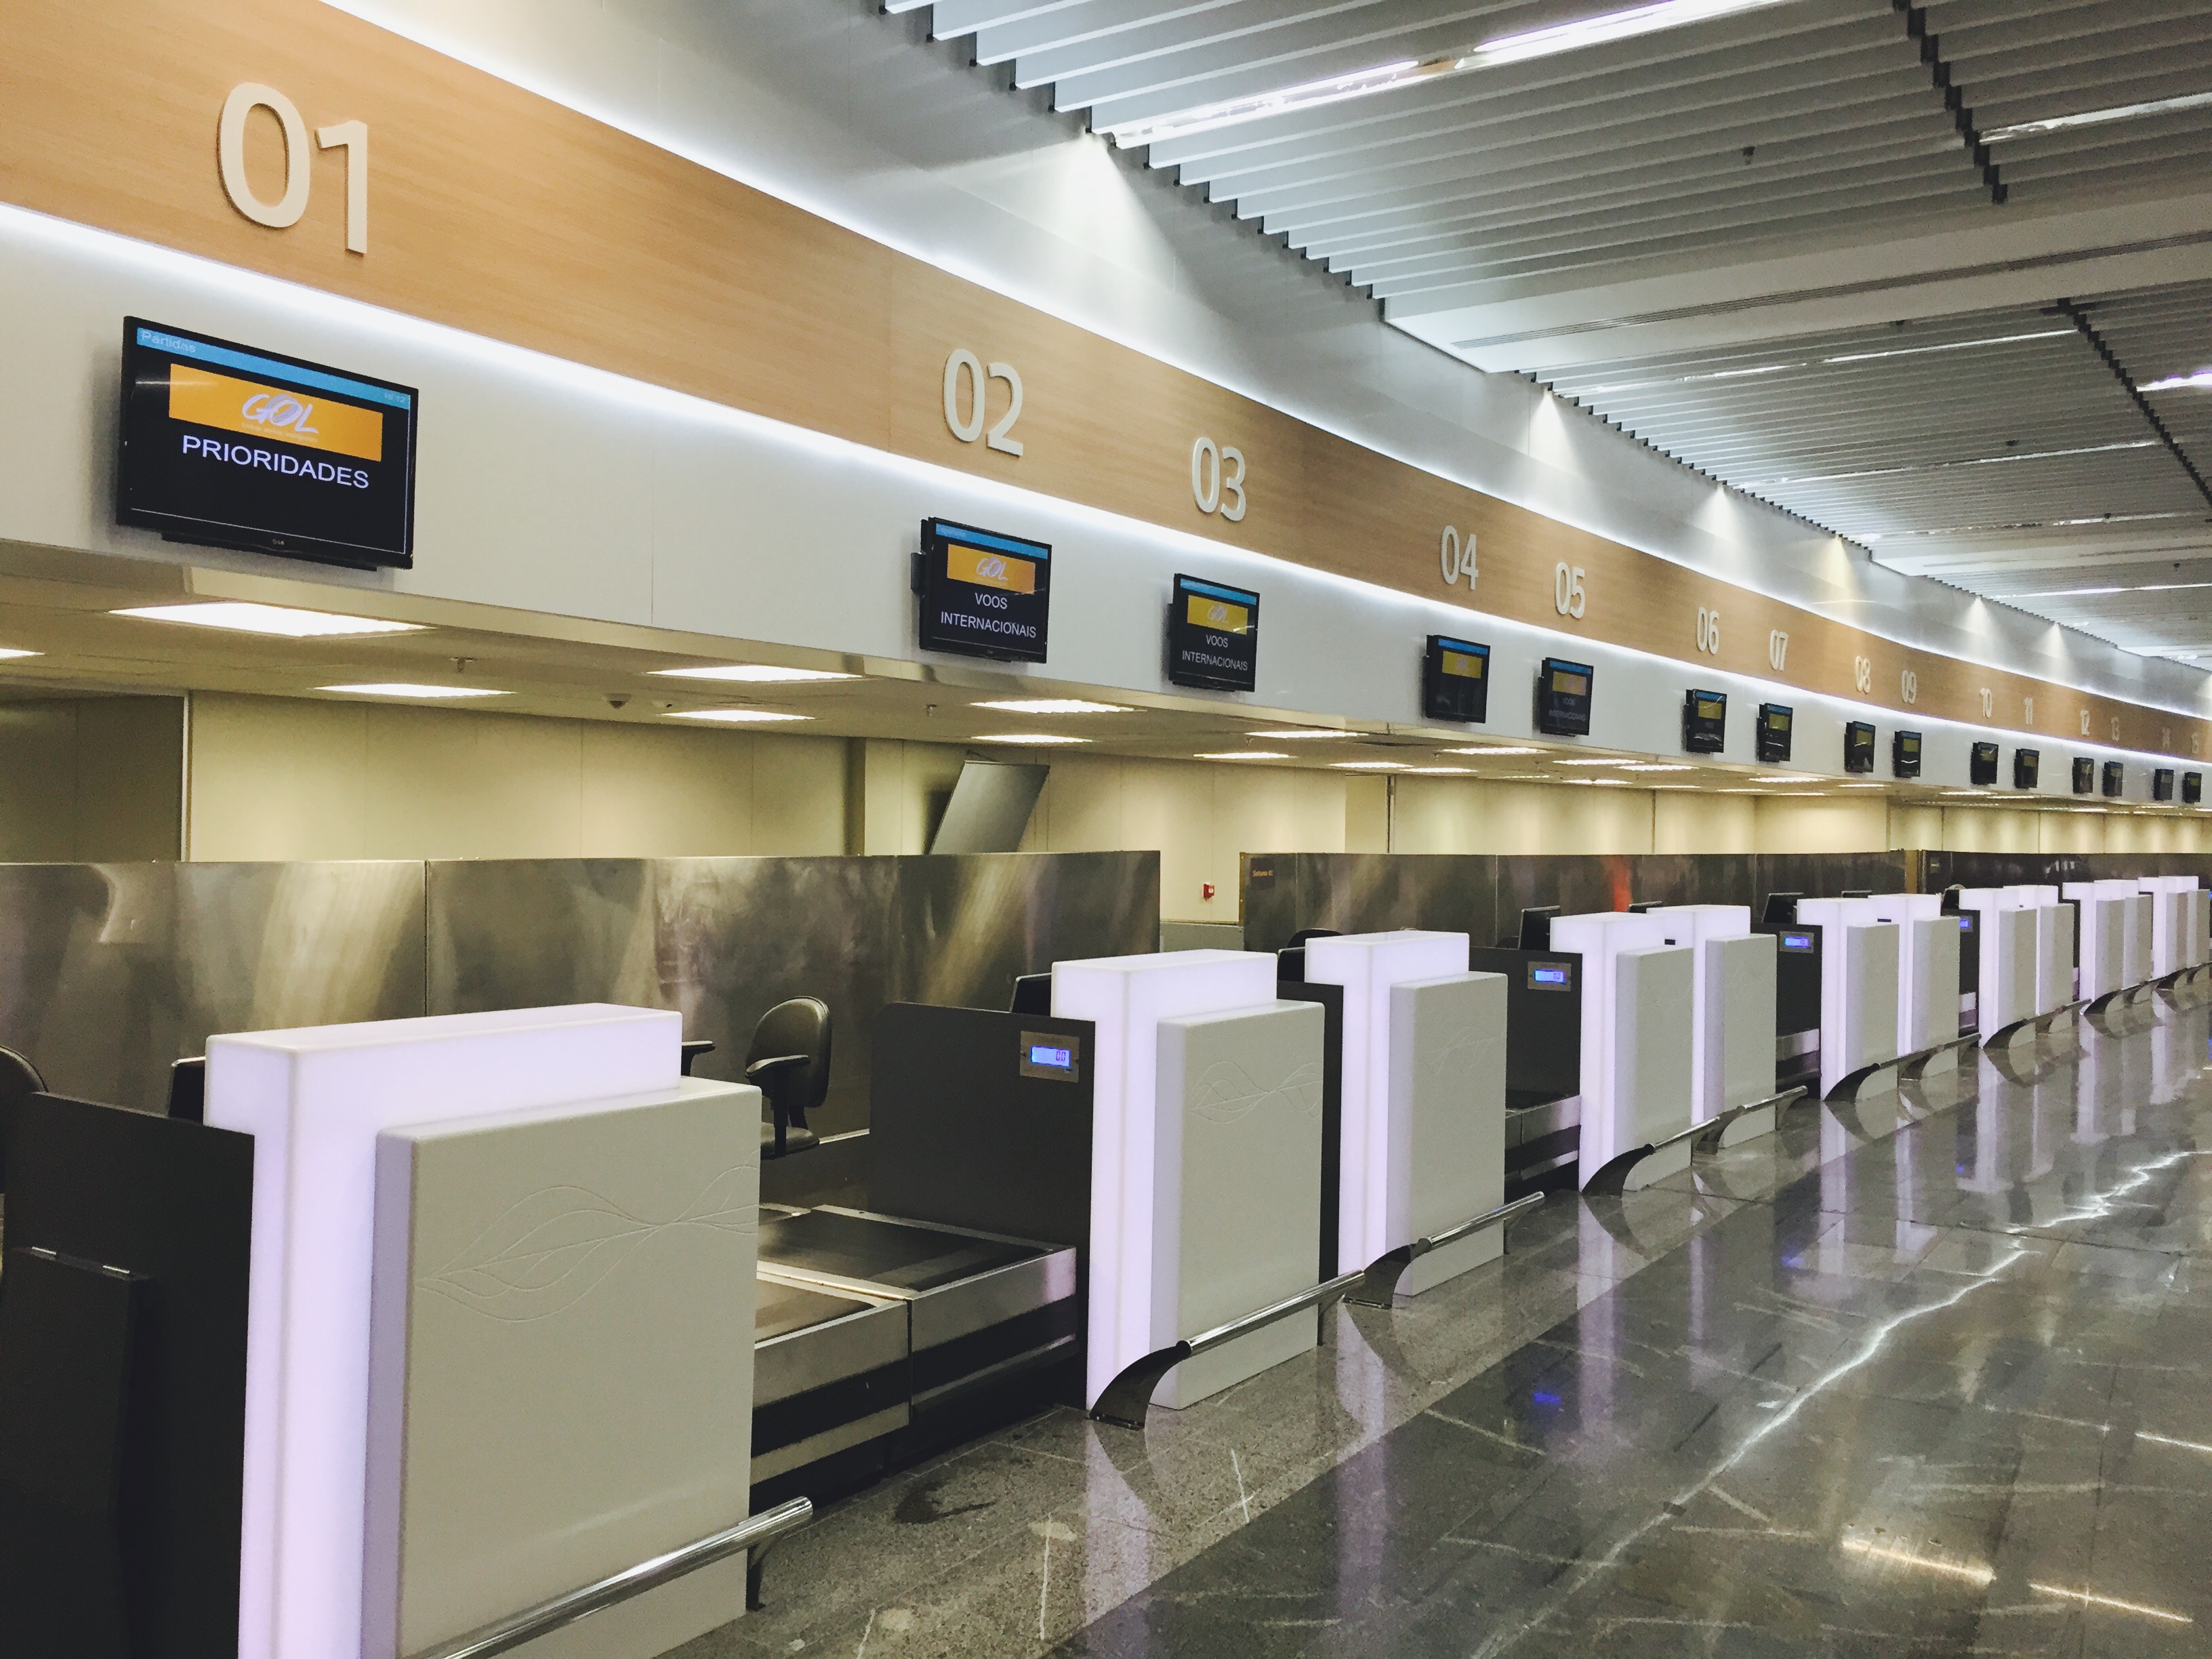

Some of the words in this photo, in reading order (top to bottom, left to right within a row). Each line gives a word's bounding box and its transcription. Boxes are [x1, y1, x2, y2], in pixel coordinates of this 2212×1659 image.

[216, 81, 368, 255] 01
[141, 329, 197, 354] Partidas
[241, 393, 319, 434] GOL
[943, 348, 1024, 457] 02
[182, 434, 369, 490] PRIORIDADES
[1191, 436, 1246, 522] 03
[976, 556, 1009, 581] GOL
[1440, 525, 1479, 591] 04
[974, 592, 1008, 610] VOOS
[1555, 561, 1586, 619] 05
[940, 611, 1037, 639] INTERNACIONAIS
[1205, 634, 1229, 649] VOOS
[1696, 607, 1720, 655] 06
[1181, 649, 1249, 672] INTERNACIONAIS
[1769, 629, 1789, 672] 07
[1855, 655, 1871, 694] 08
[1901, 670, 1917, 705] 09
[1980, 687, 1993, 719] 10
[2024, 697, 2033, 725] 11
